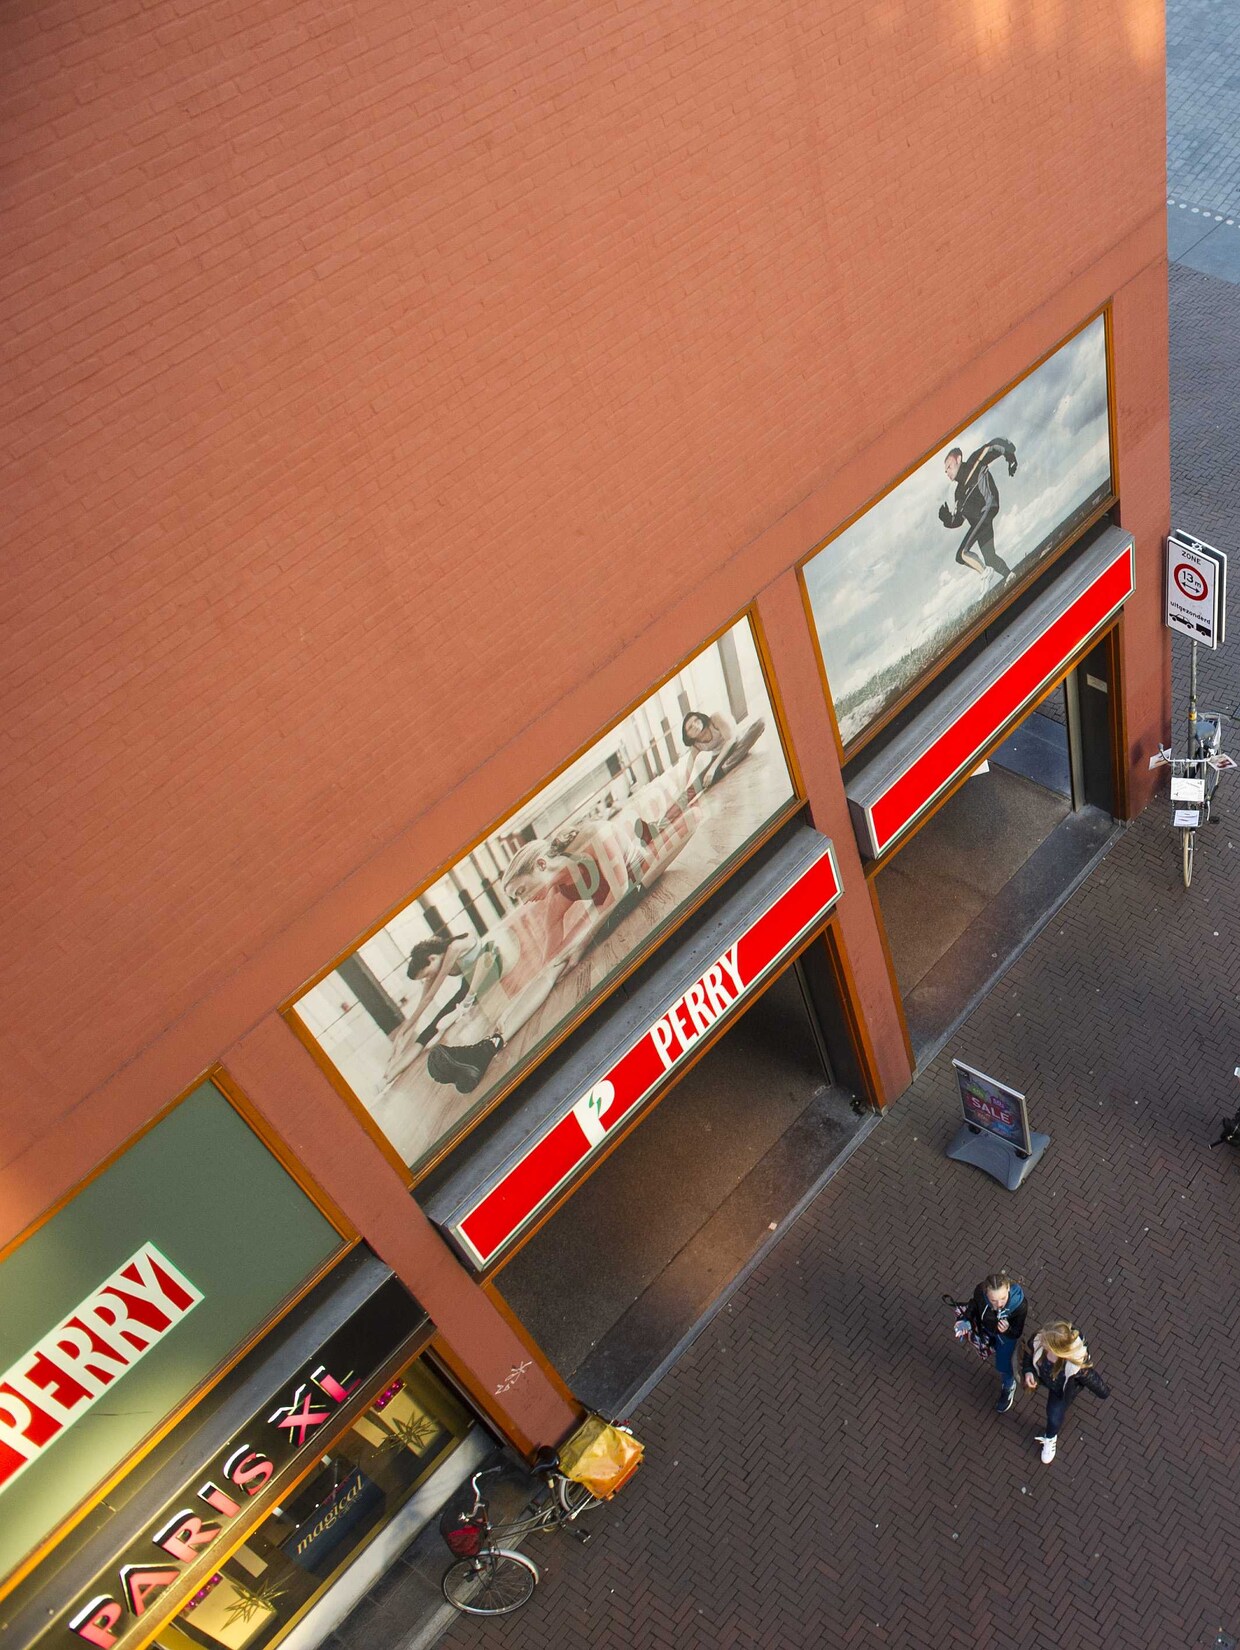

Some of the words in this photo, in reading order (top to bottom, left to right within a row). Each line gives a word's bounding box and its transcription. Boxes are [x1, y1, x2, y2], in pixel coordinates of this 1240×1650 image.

[1181, 550, 1201, 566] ZONE
[1170, 601, 1211, 625] uitgezonderd
[649, 942, 747, 1070] PERRY
[971, 1097, 1011, 1125] SALE
[0, 1243, 190, 1464] PERRY
[70, 1445, 274, 1650] PARIS
[267, 1366, 362, 1448] XL
[296, 1475, 364, 1554] magical
